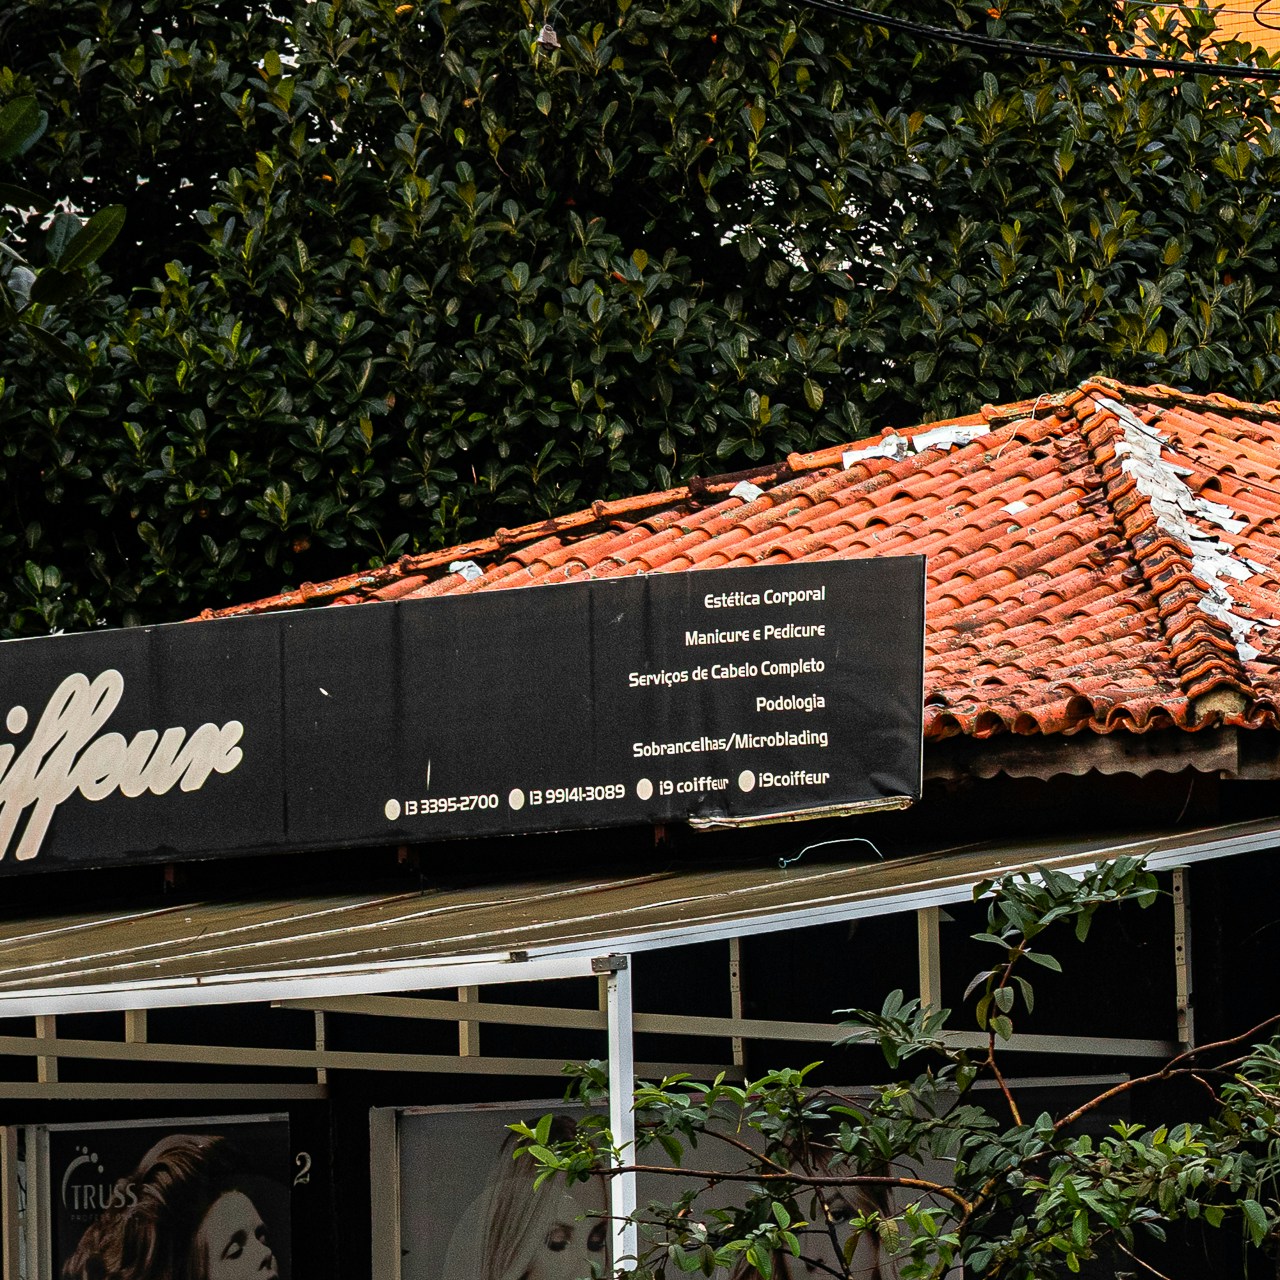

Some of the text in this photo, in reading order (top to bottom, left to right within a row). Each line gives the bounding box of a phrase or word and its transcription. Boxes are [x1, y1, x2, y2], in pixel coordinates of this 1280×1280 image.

[704, 585, 826, 609] Estética Corporal
[685, 623, 826, 646] Manicure e Pedicure
[628, 657, 826, 688] Serviços de Cabelo Completo
[756, 693, 826, 713] Podologia
[633, 730, 828, 758] Sobrancelhas/Microblading
[659, 775, 729, 796] i9 coiffeur
[758, 770, 830, 788] i9coiffeur
[404, 793, 499, 816] 13 3395-2700
[529, 783, 626, 806] 13 99141-3089
[293, 1151, 312, 1187] 2
[70, 1182, 138, 1210] TRUSS
